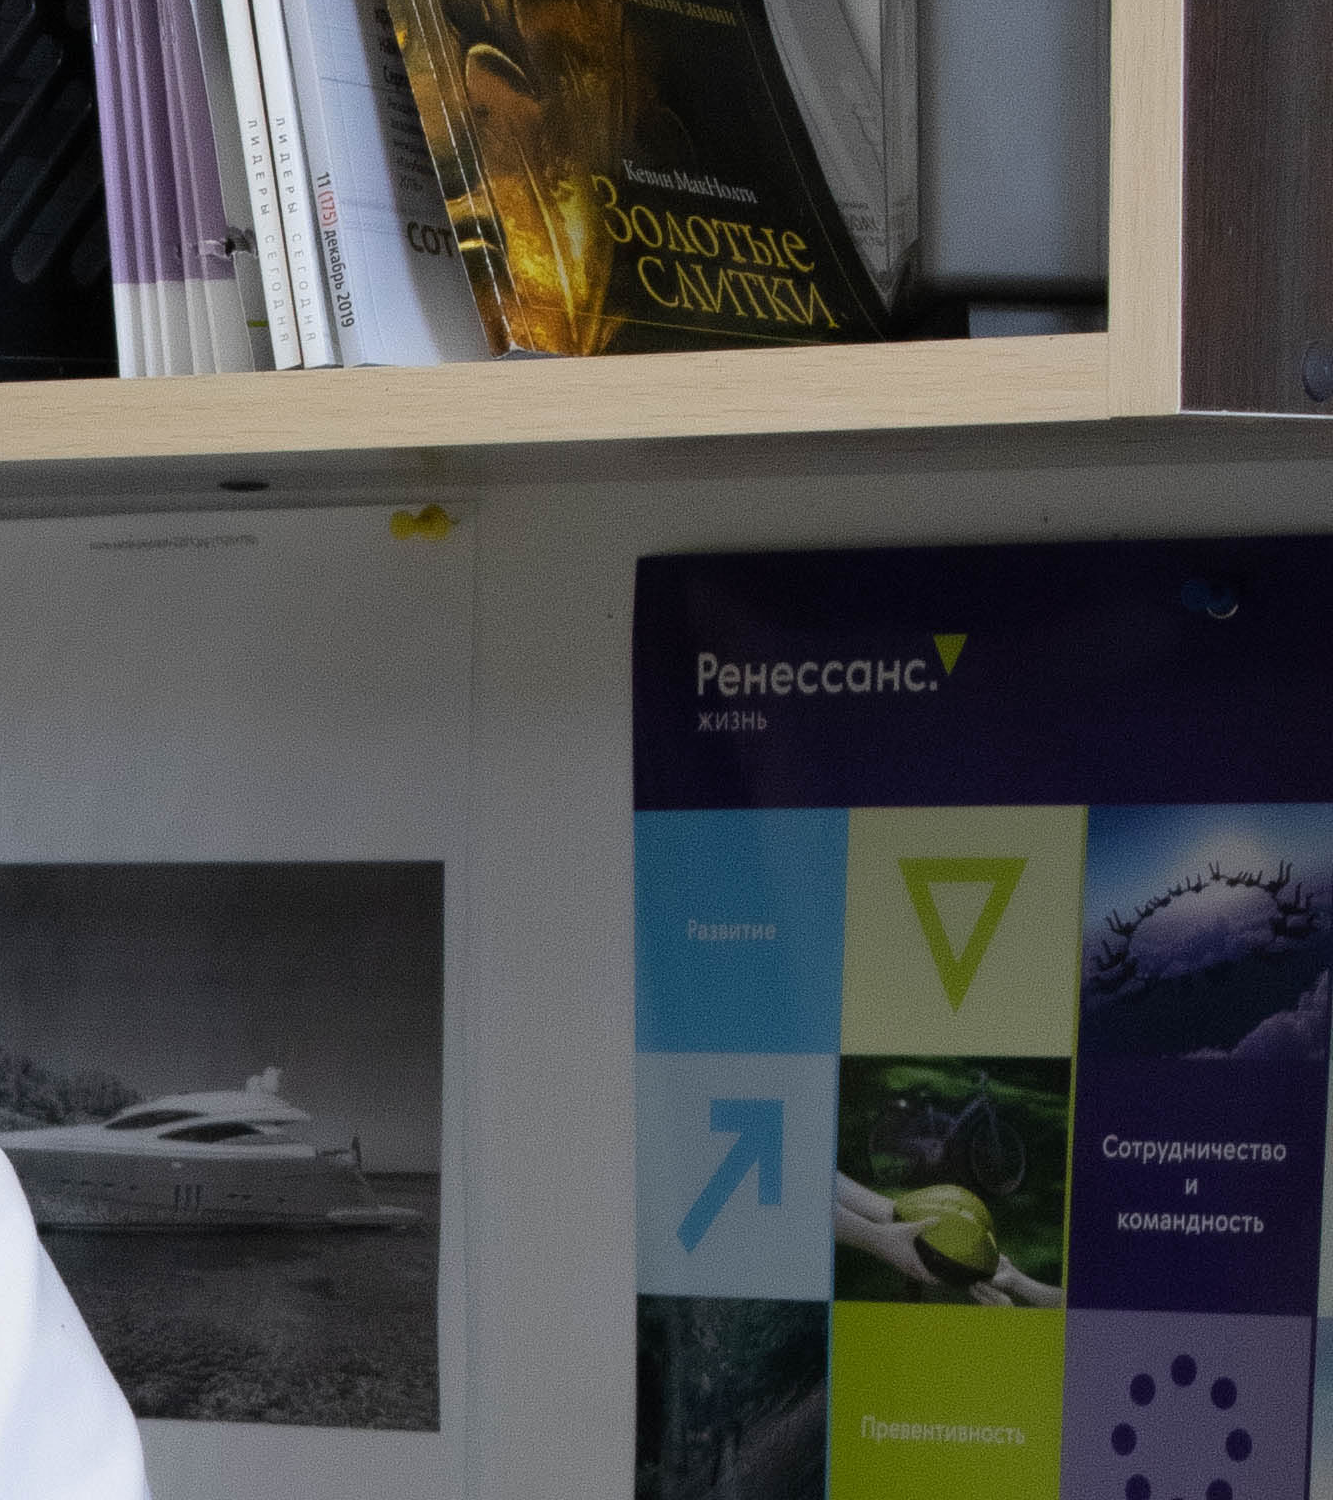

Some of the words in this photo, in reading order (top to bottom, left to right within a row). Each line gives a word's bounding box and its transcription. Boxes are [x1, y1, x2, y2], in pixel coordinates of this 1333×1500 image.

[316, 172, 332, 189] 11
[622, 159, 674, 188] Кевин
[318, 190, 339, 227] (175)
[248, 120, 271, 216] ЛИДЕРЫ
[264, 234, 290, 343] СЕГОДНЯ
[275, 117, 298, 214] ЛИДЕРЫ
[292, 233, 317, 342] СЕГОДНЯ
[324, 229, 347, 291] декабрь
[336, 292, 355, 329] 2019
[698, 653, 937, 696] Ренессанс.
[688, 918, 776, 941] Развитие
[1102, 1135, 1287, 1164] Сотрудничество
[1185, 1177, 1198, 1196] и
[1117, 1208, 1264, 1234] командность
[861, 1415, 1025, 1446] Превентивность
